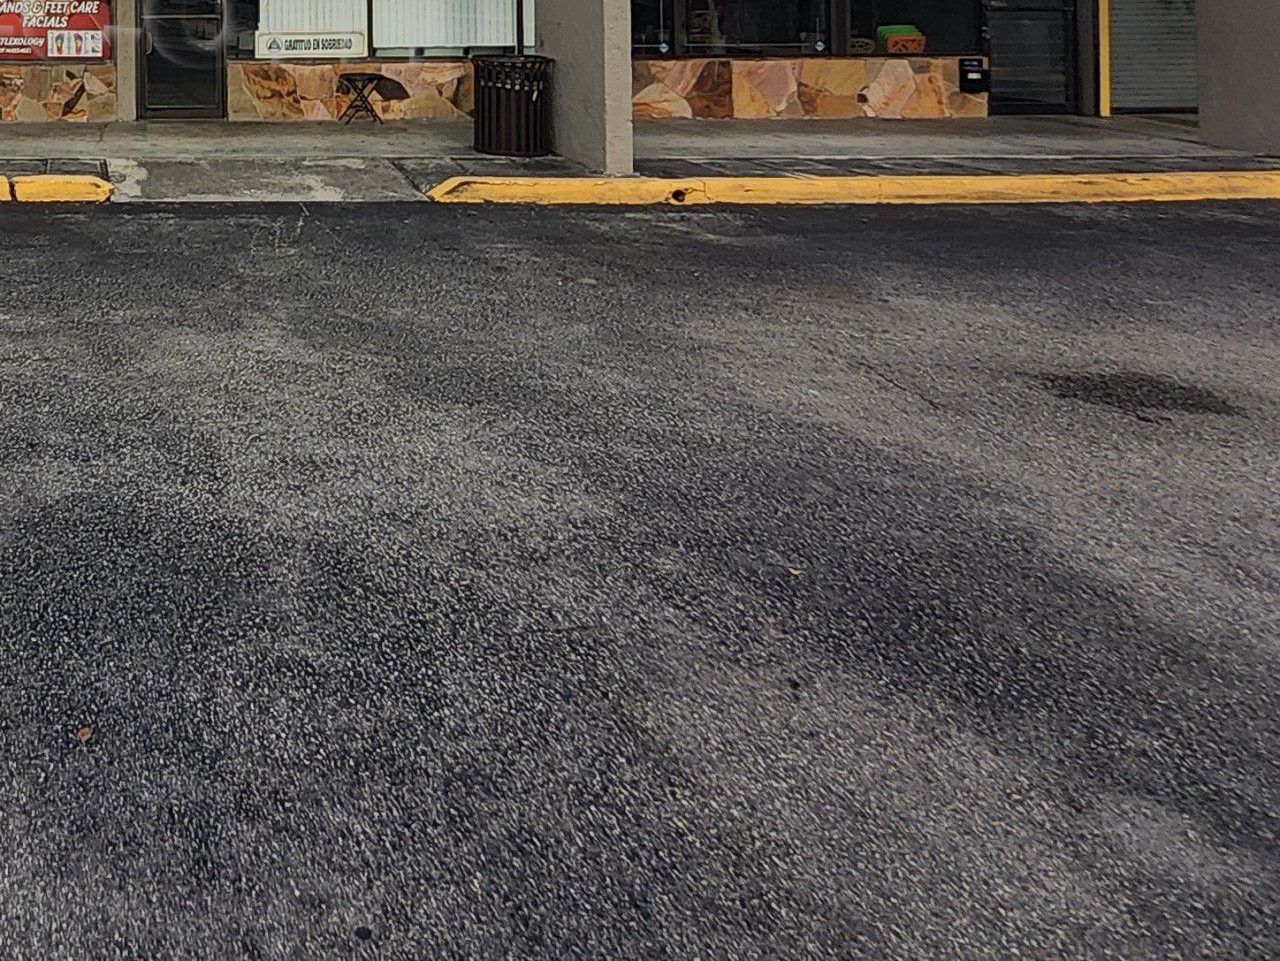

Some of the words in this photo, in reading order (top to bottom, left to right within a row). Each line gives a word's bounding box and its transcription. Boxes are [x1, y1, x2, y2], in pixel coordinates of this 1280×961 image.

[32, 2, 41, 13] &
[44, 1, 70, 13] FEET
[70, 1, 99, 13] CARE
[22, 16, 69, 28] FACIALS
